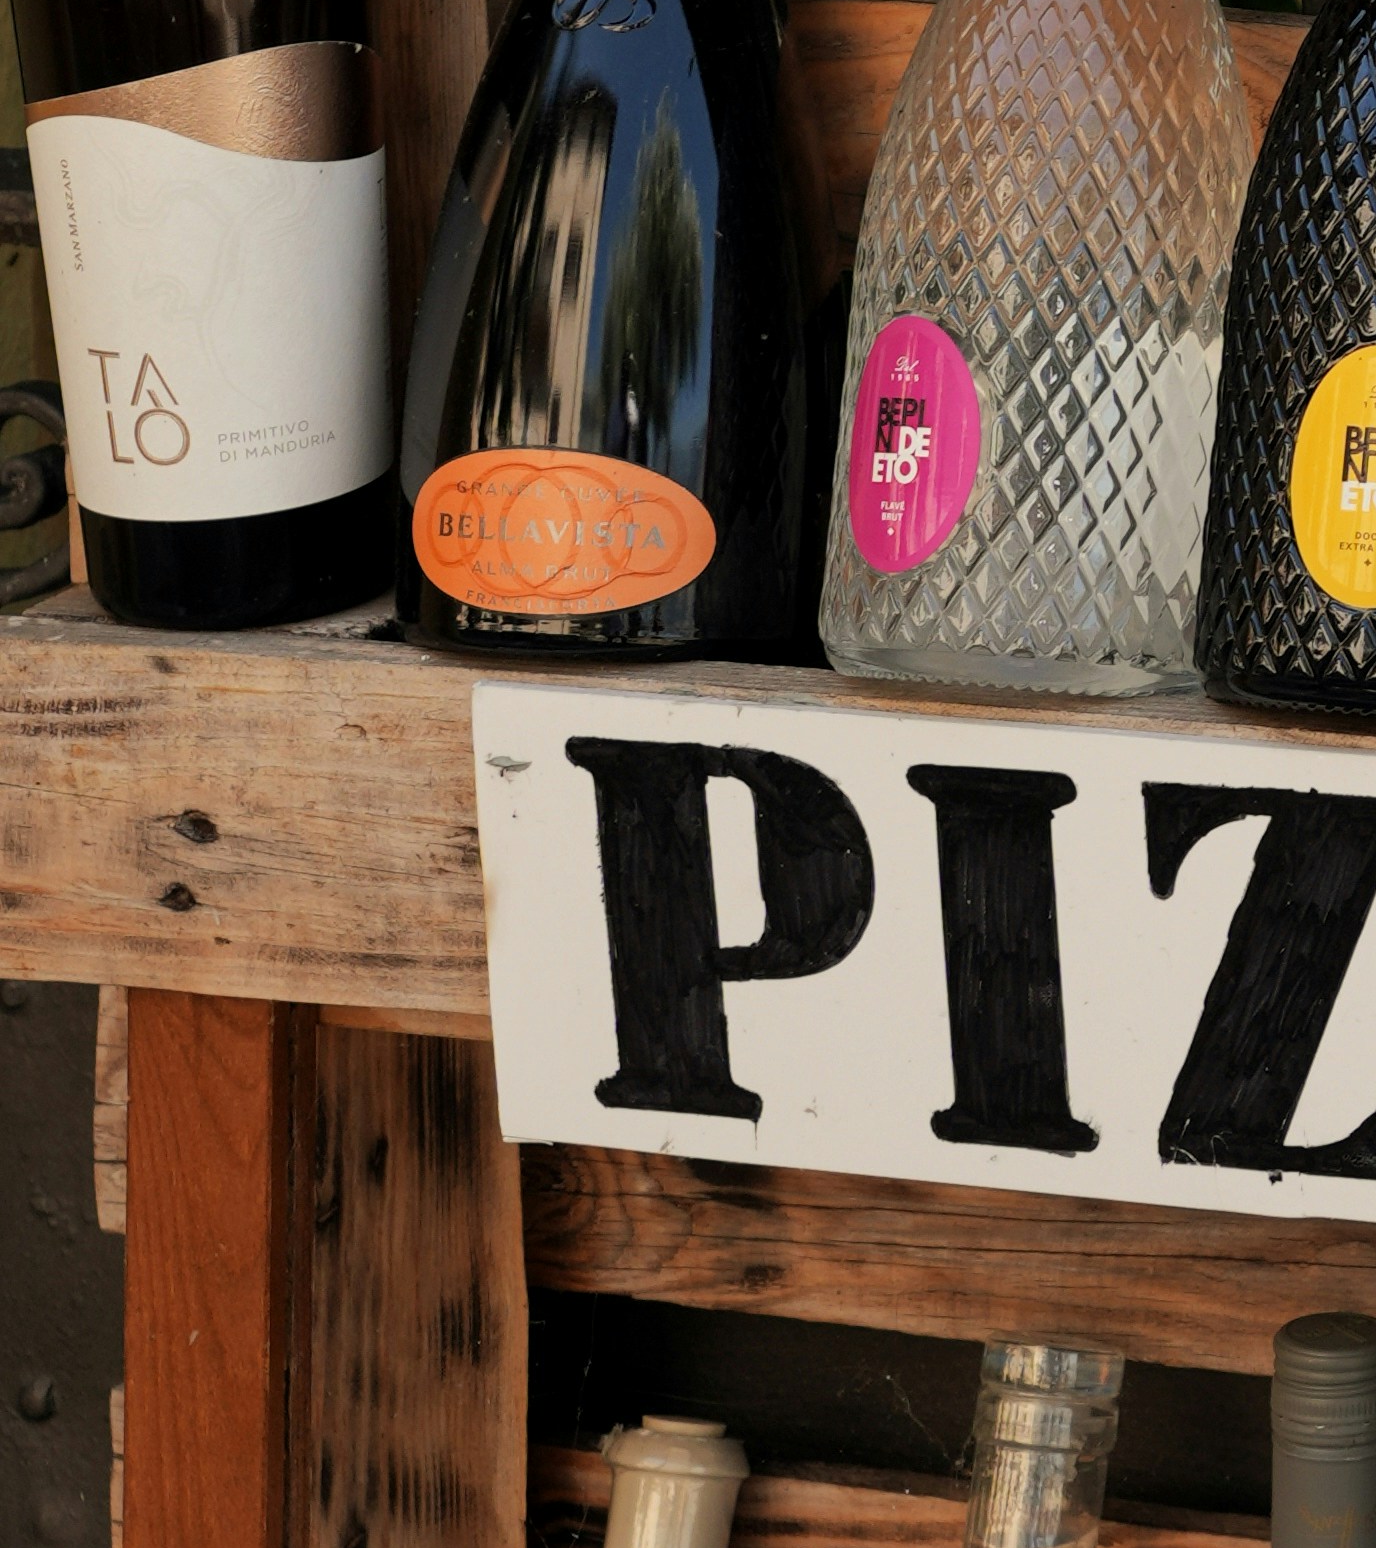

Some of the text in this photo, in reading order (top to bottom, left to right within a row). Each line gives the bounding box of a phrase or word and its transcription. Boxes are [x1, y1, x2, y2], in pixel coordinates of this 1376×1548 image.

[59, 157, 86, 273] SAN MARZANO
[217, 418, 310, 446] PRIMITIVO
[218, 429, 337, 464] DI MANDURIA
[871, 452, 919, 485] ETO
[437, 510, 668, 550] BELLAVISTA
[1338, 542, 1374, 554] EXTRA
